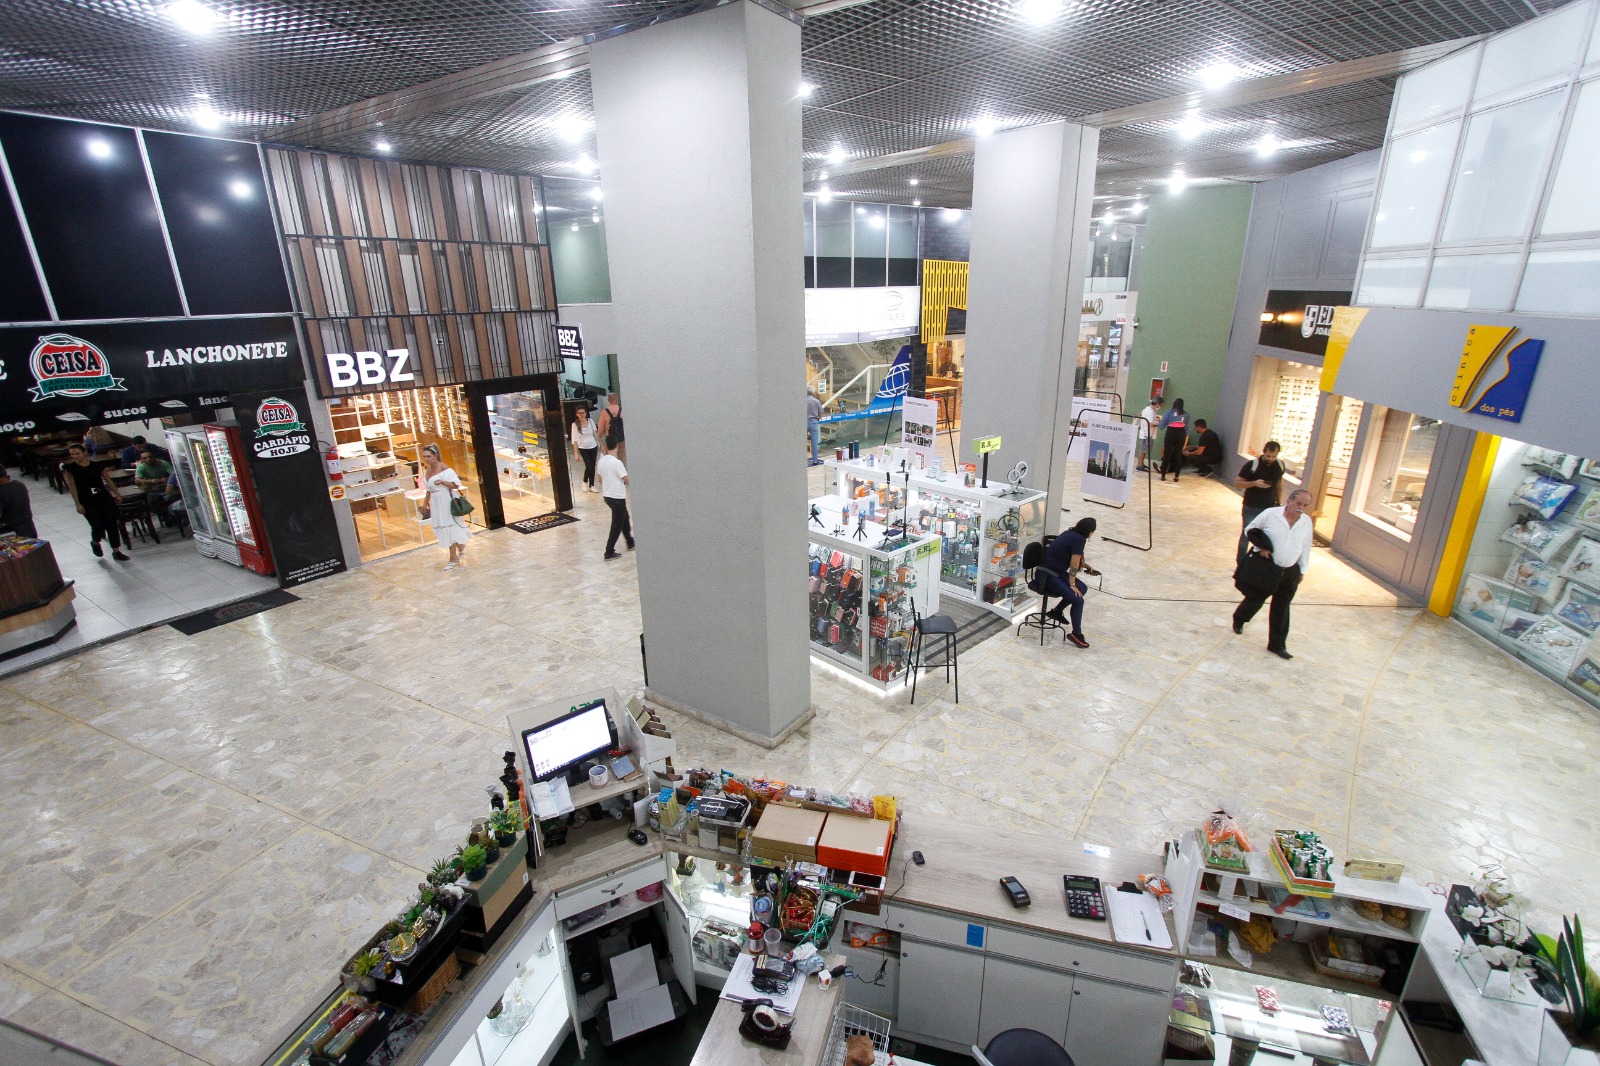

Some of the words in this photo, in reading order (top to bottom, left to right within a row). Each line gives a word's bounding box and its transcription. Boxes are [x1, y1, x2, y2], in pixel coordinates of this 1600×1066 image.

[558, 329, 578, 347] BBZ
[145, 341, 288, 368] LANCHONETE
[41, 350, 101, 375] CEISA
[325, 348, 414, 388] BBZ
[43, 376, 98, 387] LANCHONETE
[48, 381, 109, 392] RESTAURANTE
[104, 406, 147, 419] sucos
[261, 407, 292, 422] CEISA
[1480, 403, 1495, 412] dos
[1498, 407, 1515, 417] pés
[0, 420, 36, 433] oço
[253, 435, 311, 451] CARDÁPIO
[270, 446, 298, 457] HOJE
